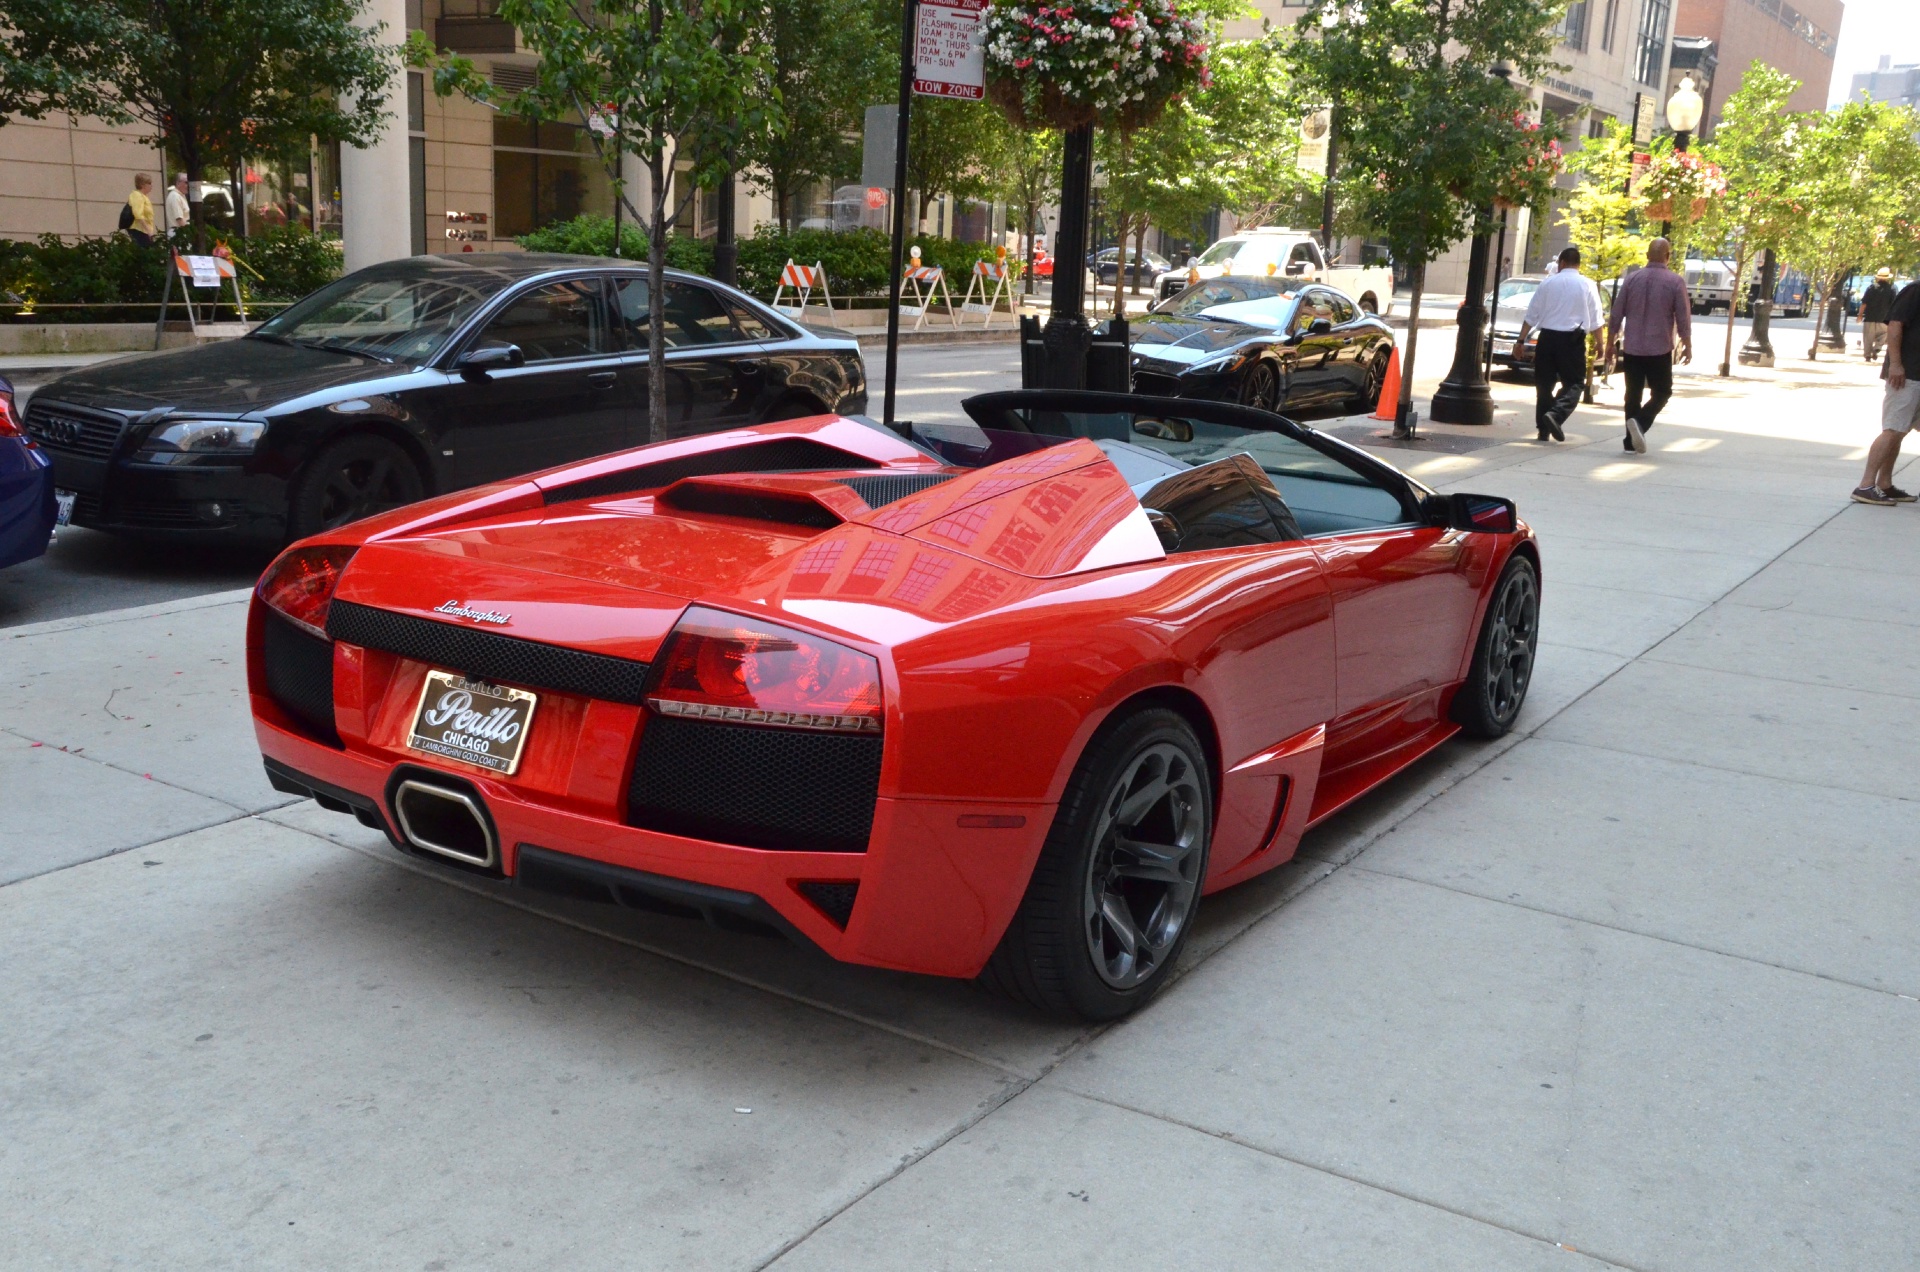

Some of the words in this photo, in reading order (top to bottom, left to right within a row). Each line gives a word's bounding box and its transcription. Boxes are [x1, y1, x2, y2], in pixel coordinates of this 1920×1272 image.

[962, 0, 981, 9] ZONE
[921, 9, 936, 18] USE
[921, 18, 957, 30] FLASHING
[959, 23, 981, 33] LIGHT
[921, 27, 929, 36] 10
[931, 29, 942, 38] AM
[949, 31, 955, 40] 8
[957, 32, 968, 41] PM
[920, 37, 937, 46] MON
[946, 39, 971, 51] THURS
[920, 46, 928, 55] 10
[929, 47, 940, 56] AM
[948, 50, 953, 58] 6
[954, 50, 966, 59] PM
[919, 55, 932, 65] FRI
[939, 58, 955, 67] SUN
[918, 81, 942, 93] TOW
[948, 84, 978, 97] ZONE
[433, 600, 512, 624] Lamborghini
[459, 679, 502, 697] PERILLO
[425, 690, 520, 744] Perillo
[442, 730, 490, 753] CHICAGO
[422, 741, 462, 757] LAMBORGHINI
[462, 751, 479, 762] GOLD
[478, 756, 499, 767] COAST
